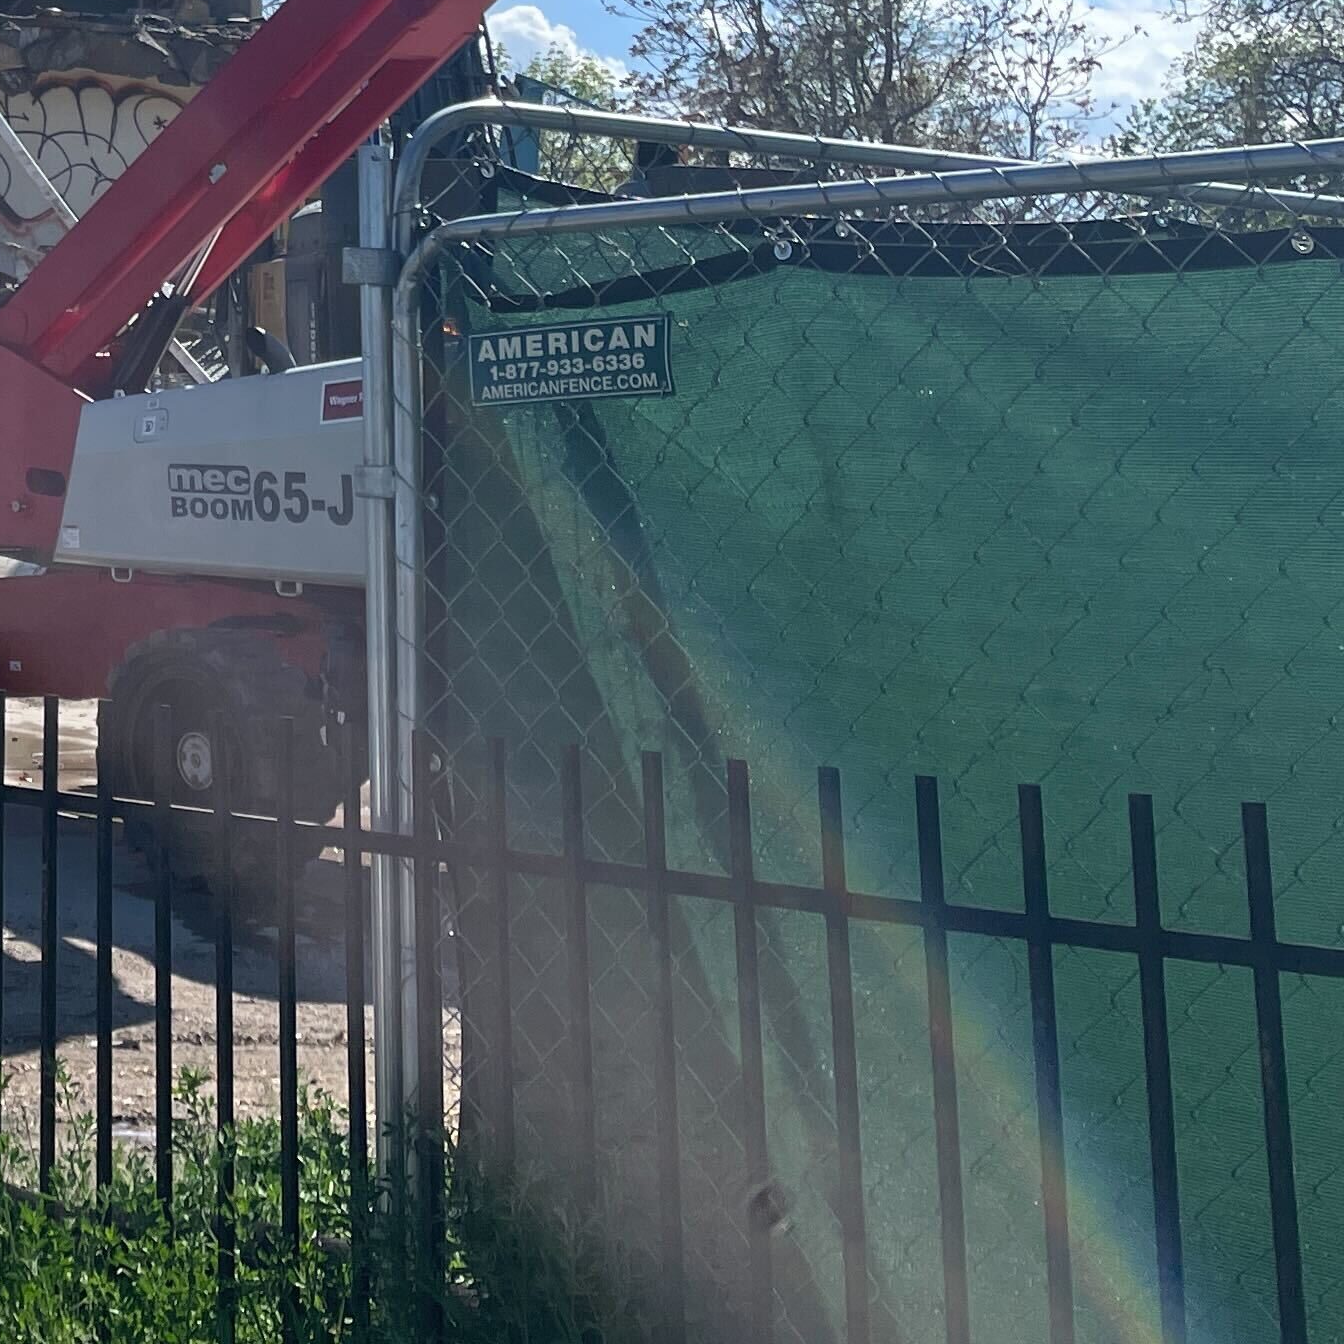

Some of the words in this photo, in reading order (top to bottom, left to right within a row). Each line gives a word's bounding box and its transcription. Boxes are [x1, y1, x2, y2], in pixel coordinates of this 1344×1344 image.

[478, 323, 656, 362] AMERICAN
[489, 352, 646, 381] 1-877-933-6336
[481, 372, 658, 400] AMERICANFENCE.COM
[169, 467, 251, 494] mec
[171, 496, 254, 521] BOOM
[253, 471, 354, 526] 65-J
